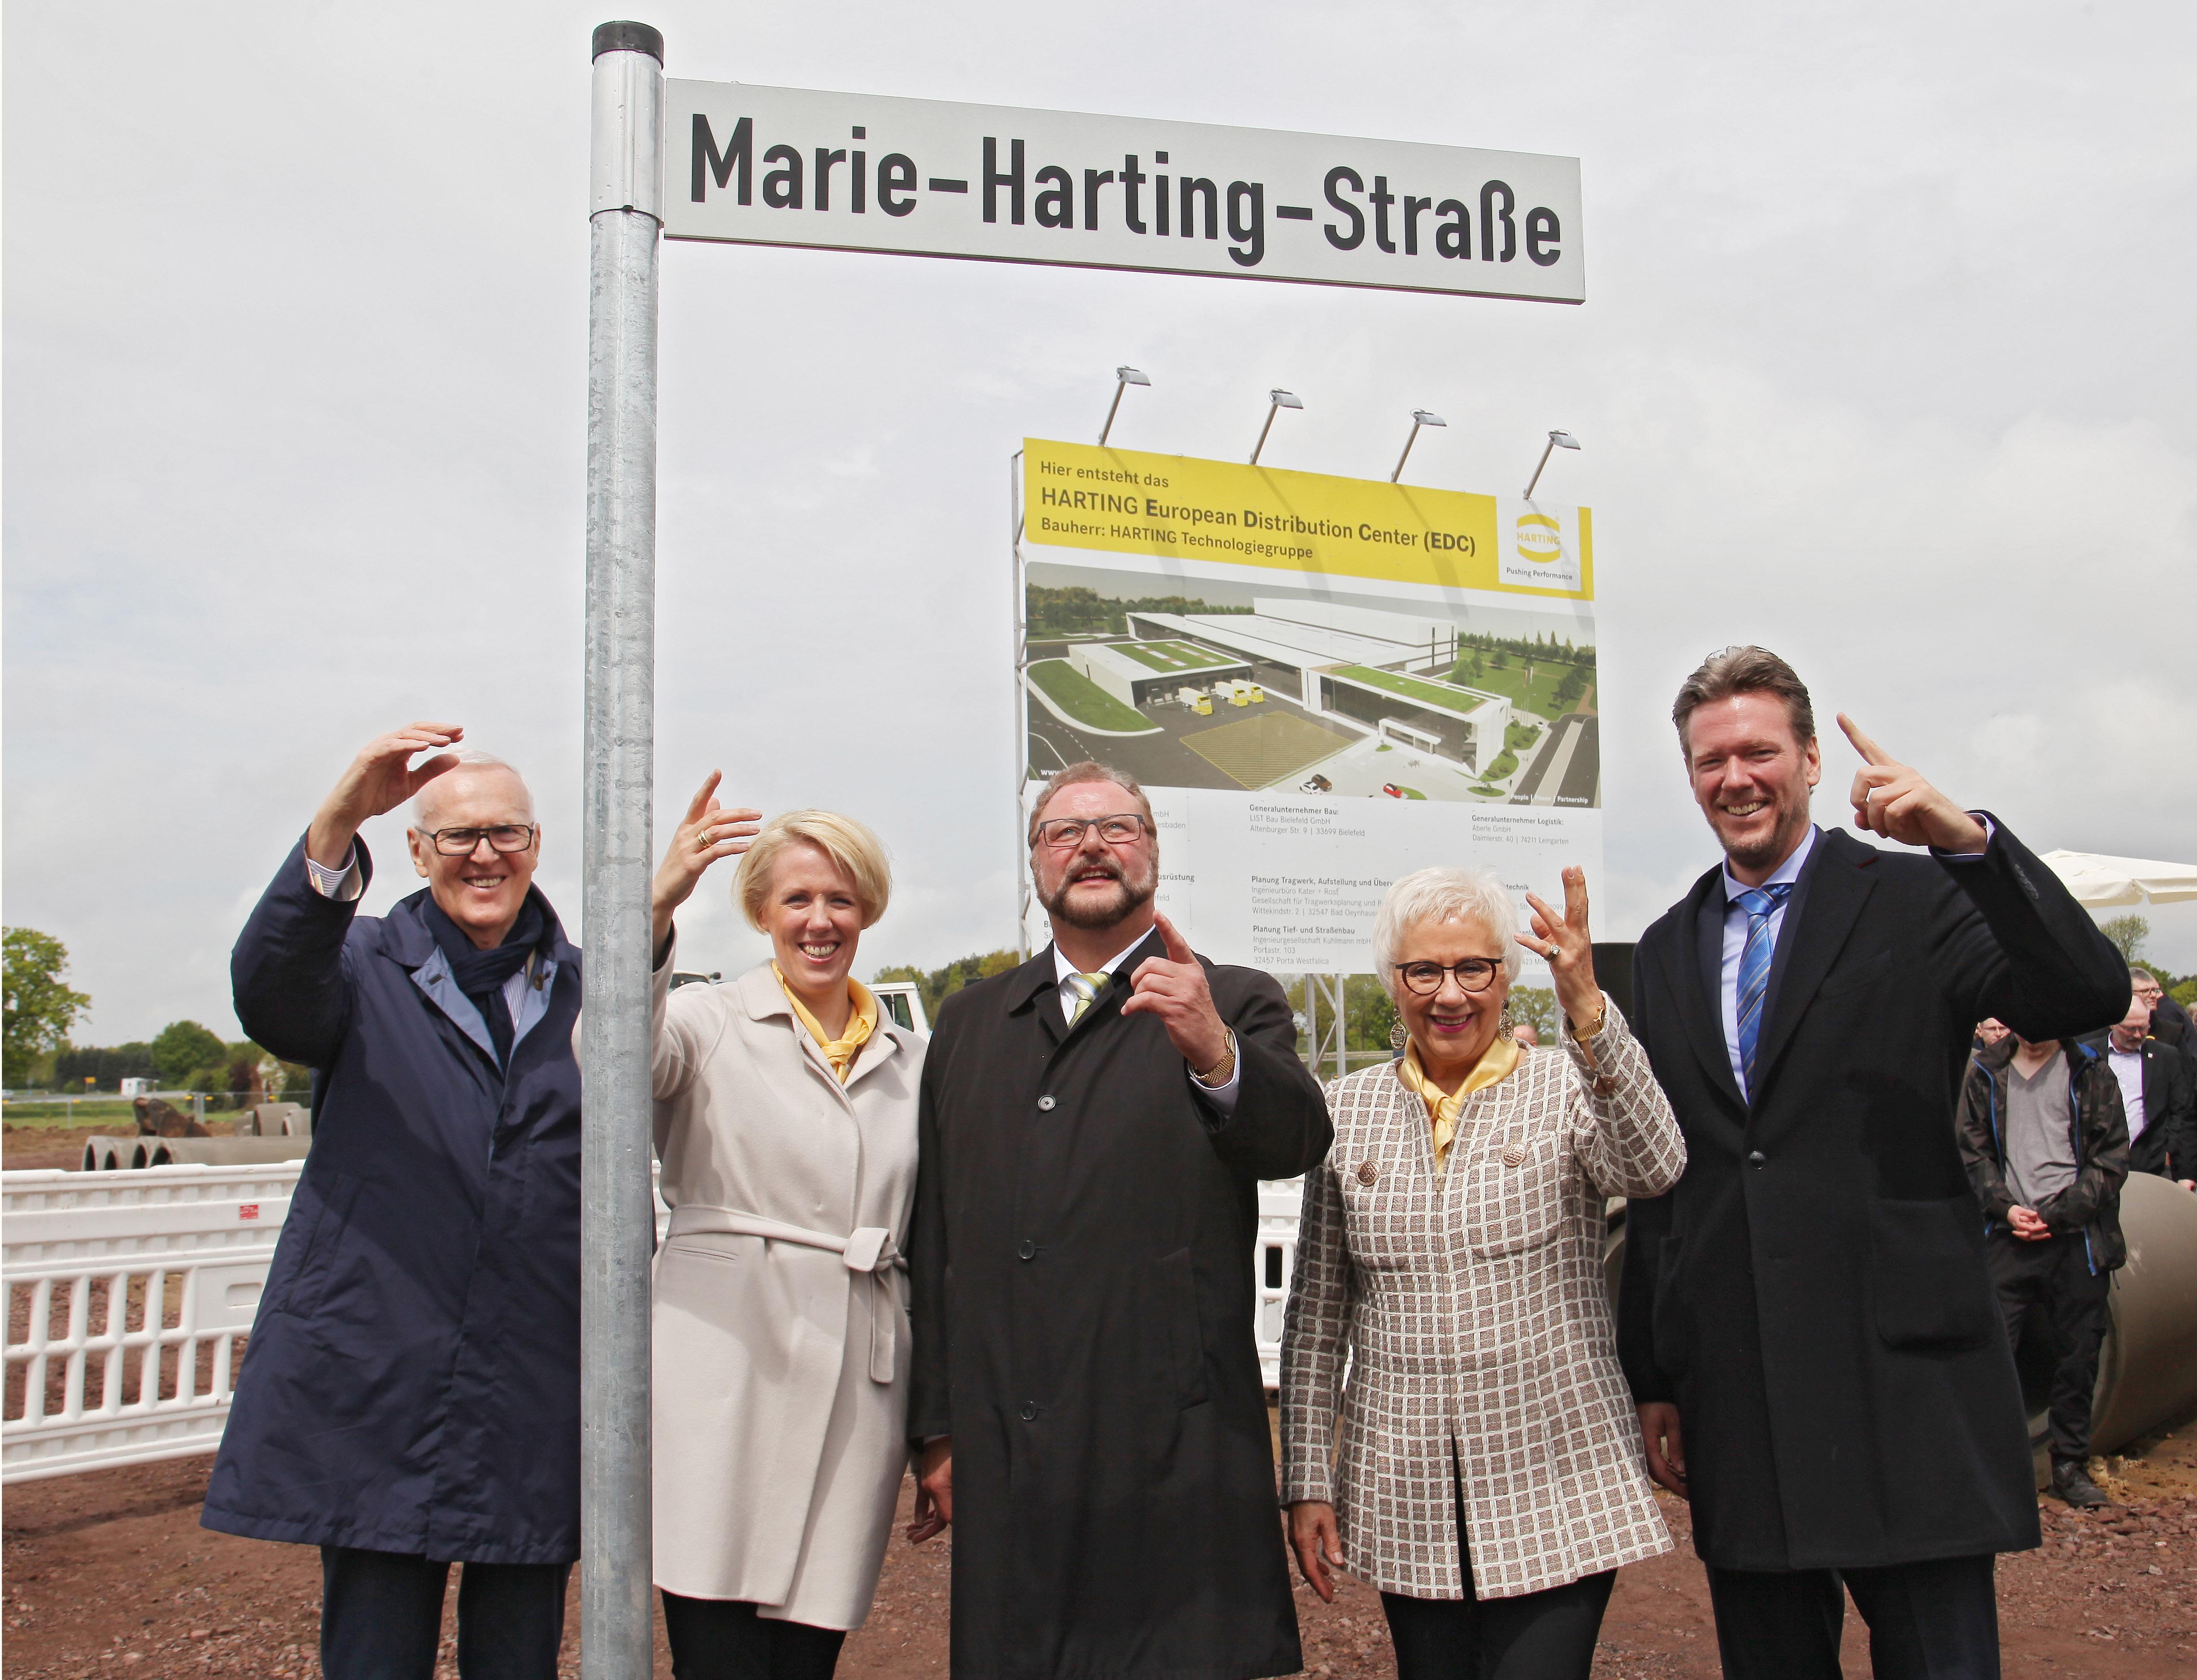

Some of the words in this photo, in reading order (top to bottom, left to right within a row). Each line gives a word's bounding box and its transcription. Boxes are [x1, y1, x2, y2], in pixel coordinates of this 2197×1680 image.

[690, 114, 1561, 267] Marie-Harting-Straße
[1041, 461, 1072, 476] Hier
[1077, 468, 1139, 485] entsteht
[1143, 473, 1169, 488] das
[1042, 487, 1138, 514] HARTING
[1146, 498, 1236, 526] European
[1244, 510, 1352, 539] Distribution
[1359, 524, 1418, 546] Center
[1424, 531, 1475, 557] (EDC)
[1042, 517, 1105, 536] Bauherr:
[1111, 525, 1177, 544] HARTING
[1181, 531, 1314, 560] Technologiegruppe
[1516, 532, 1560, 545] HARTING
[1506, 567, 1531, 577] Pushing
[1533, 570, 1573, 580] Performance
[1510, 793, 1529, 801] People
[1557, 795, 1588, 804] Partnership
[1249, 804, 1322, 814] Generalunternehmer
[1156, 821, 1186, 829] iesbaden
[1280, 816, 1308, 824] Bielefeld
[1310, 817, 1330, 825] GmbH
[1472, 815, 1536, 824] Generalunternehmer
[1538, 818, 1564, 826] Logistik:
[1250, 824, 1287, 835] Altenburger
[1338, 828, 1365, 836] Bielefeld
[1539, 837, 1569, 846] Leingarten
[1158, 873, 1195, 883] usrüstung
[1251, 875, 1279, 885] Planung
[1282, 876, 1316, 885] Tragwerk,
[1318, 878, 1357, 887] Aufstellung
[1252, 886, 1296, 895] Ingenieurbüro
[1252, 896, 1291, 904] Gesellschaft
[1305, 898, 1362, 908] Tragwerksplanung
[1253, 925, 1281, 935] Planung
[1253, 936, 1321, 945] Ingenieurgesellschaft
[1254, 946, 1281, 954] Portastr.
